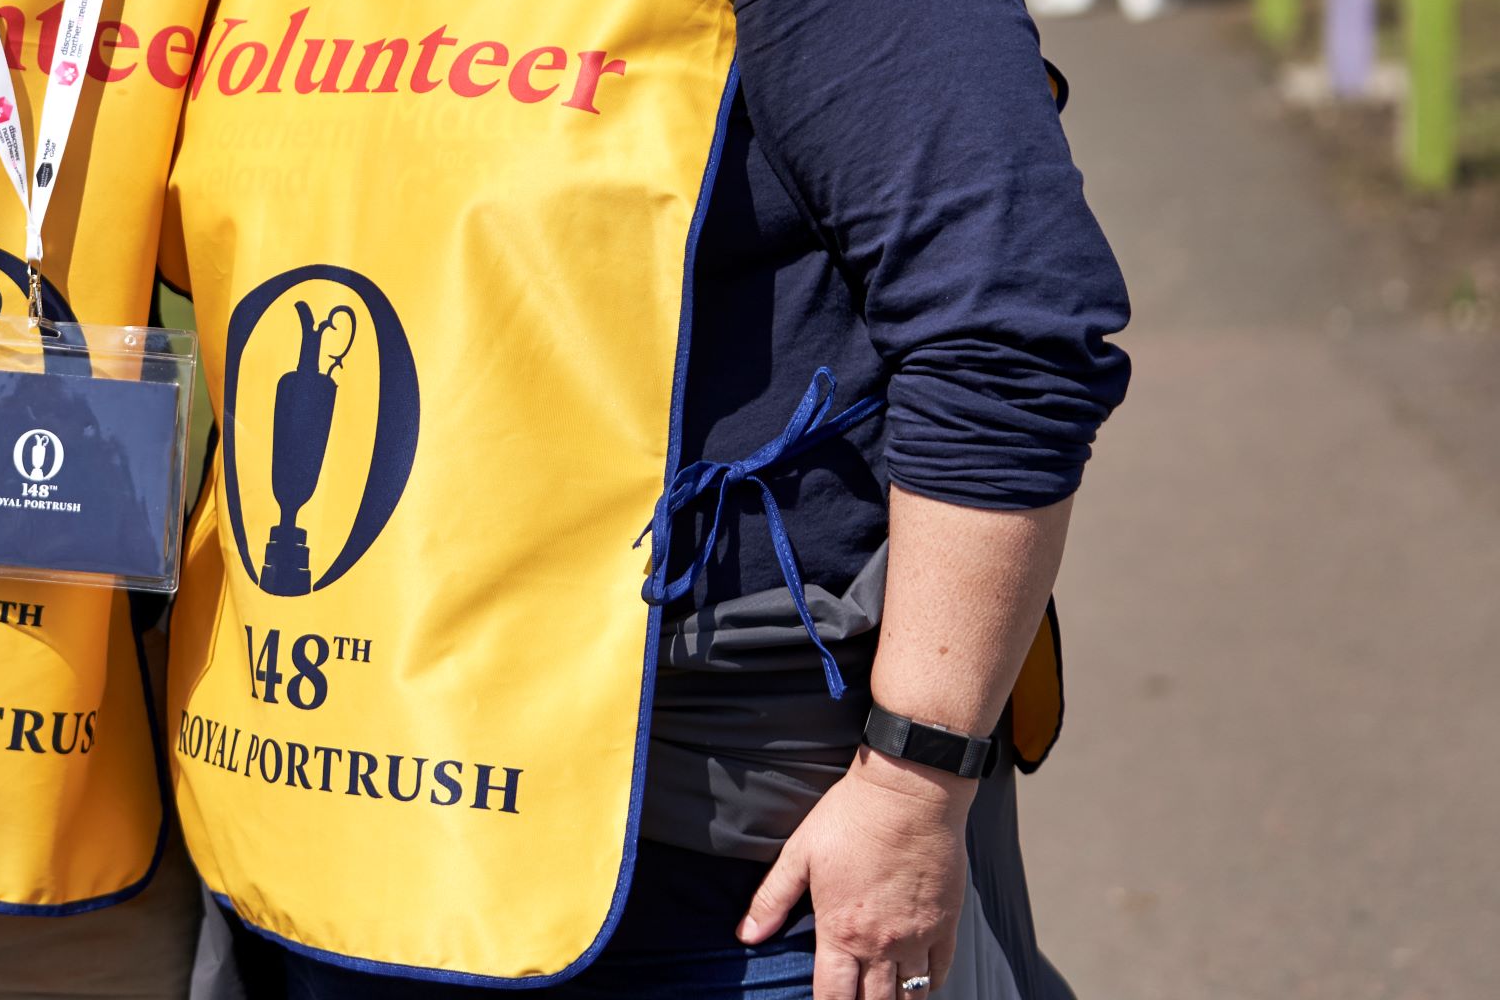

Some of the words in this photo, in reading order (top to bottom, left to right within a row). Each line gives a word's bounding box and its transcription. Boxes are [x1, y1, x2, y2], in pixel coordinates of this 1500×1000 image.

[191, 6, 627, 116] Volunteer
[23, 499, 81, 513] PORTRUSH
[178, 709, 242, 773] ROYAL
[243, 733, 524, 814] PORTRUSH
